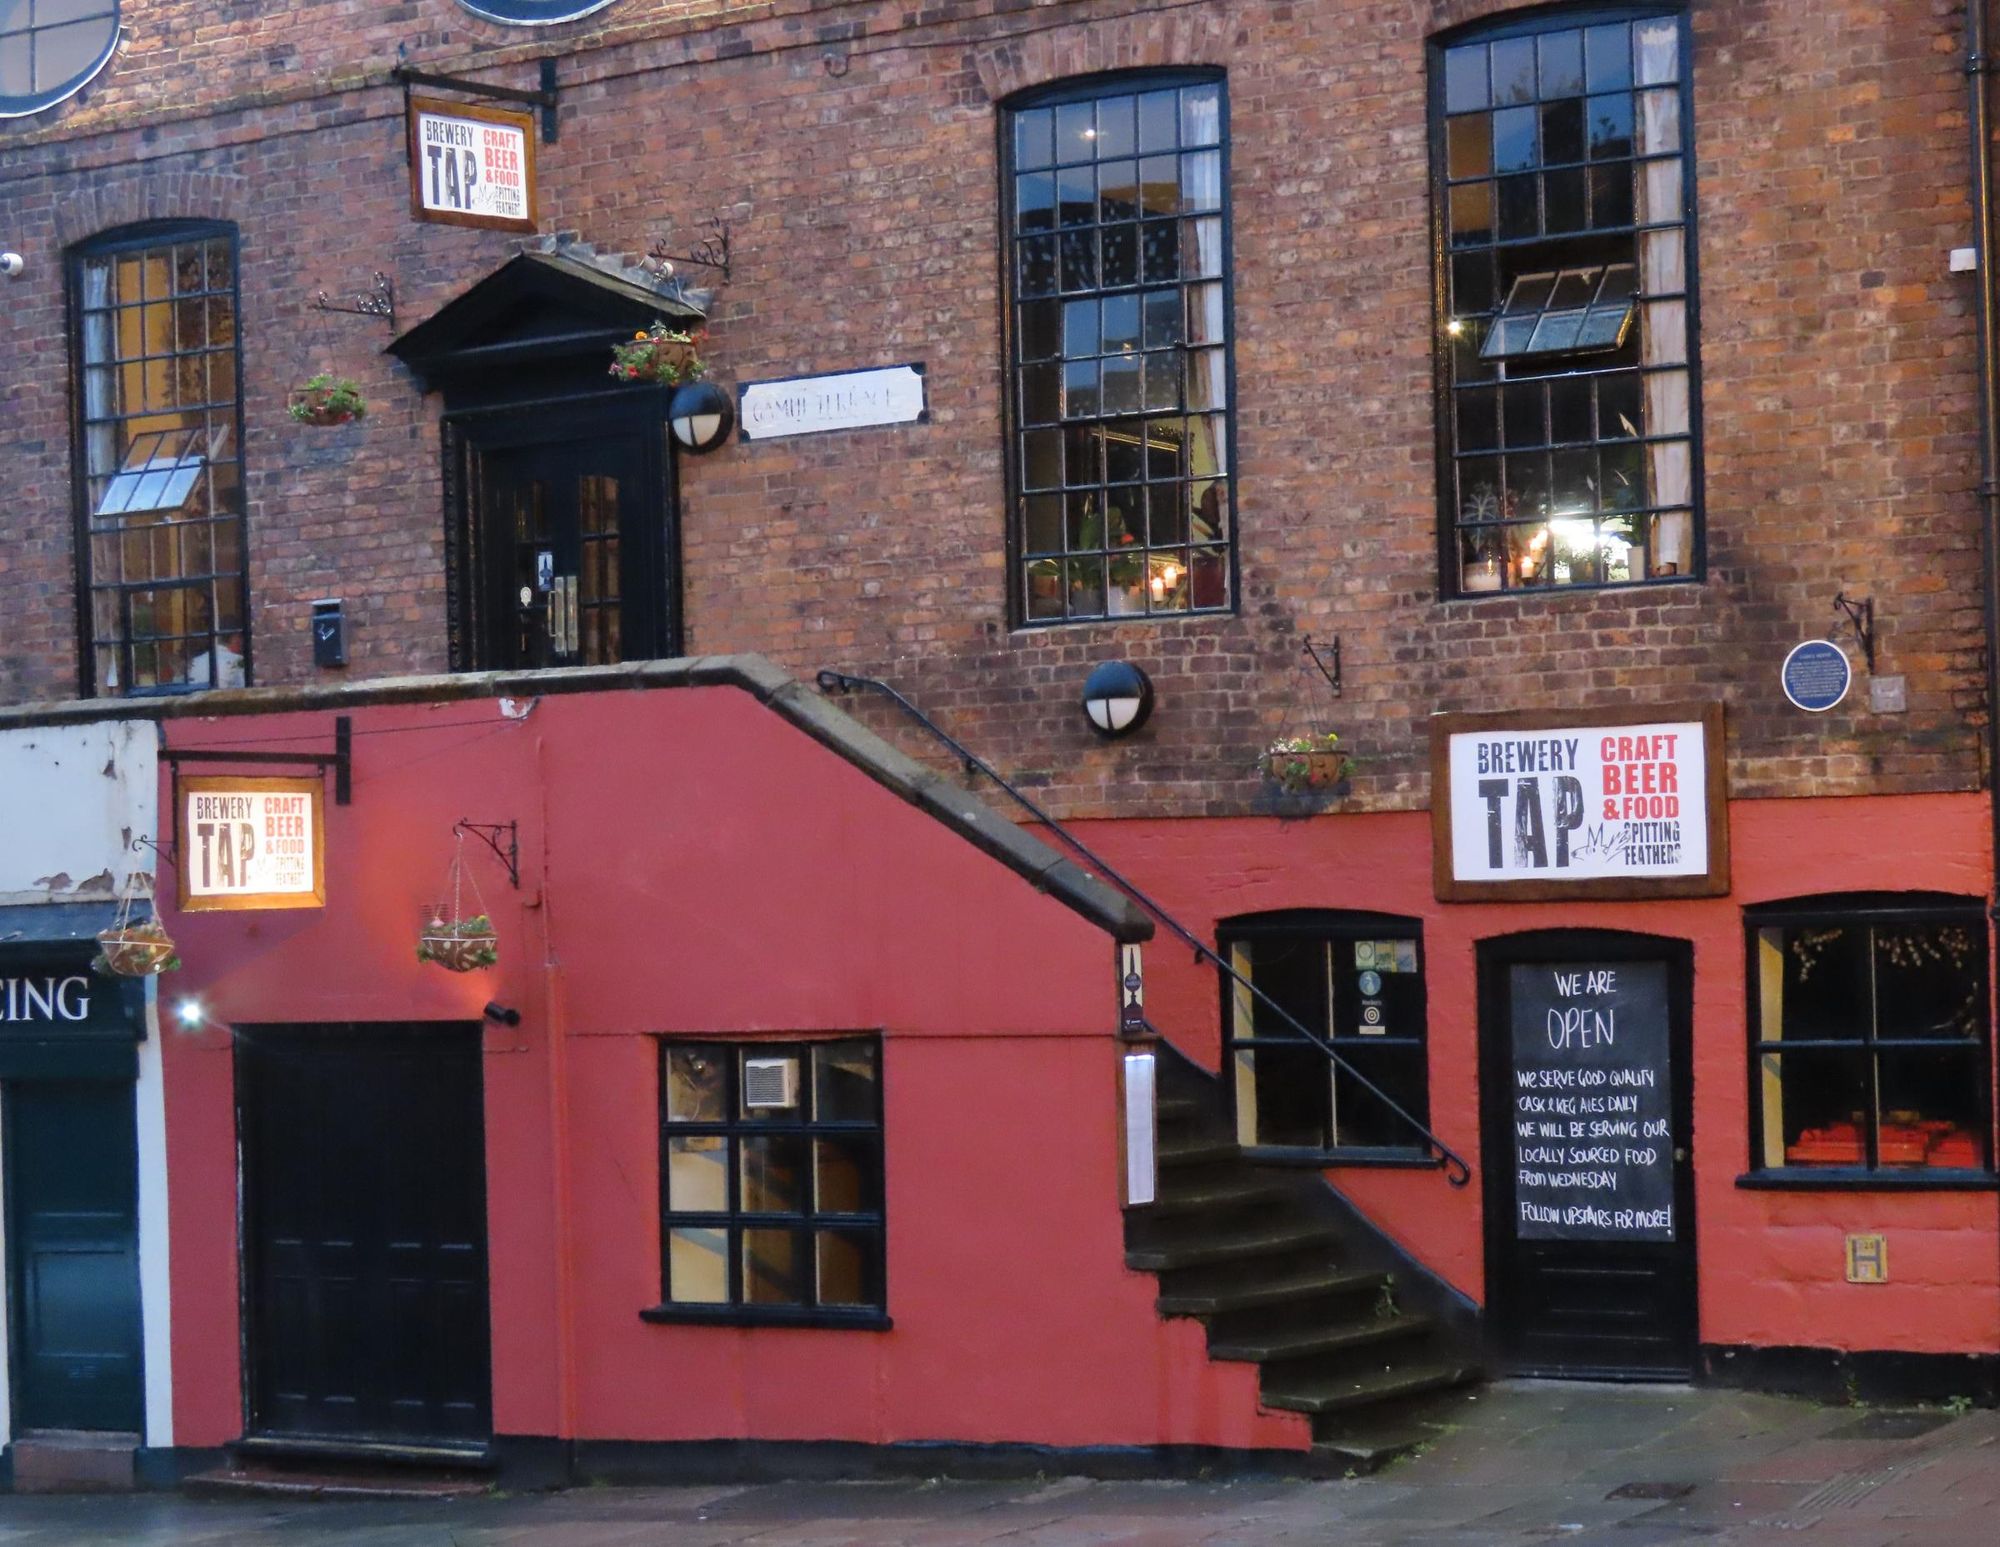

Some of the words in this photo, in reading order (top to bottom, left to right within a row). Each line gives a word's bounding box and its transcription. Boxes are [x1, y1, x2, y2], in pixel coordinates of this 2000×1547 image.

[426, 120, 474, 147] BREWERY
[483, 129, 517, 150] CRAFT
[484, 147, 518, 171] BEER
[427, 144, 478, 209] TAP
[1477, 738, 1579, 774] BREWERY
[1600, 734, 1678, 763] CRAFT
[1602, 762, 1678, 796] BEER
[197, 796, 253, 820] BREWERY
[264, 797, 304, 814] CRAFT
[265, 816, 304, 837] BEER
[1478, 775, 1585, 869] TAP
[1623, 820, 1680, 843] SPITTING
[197, 822, 255, 888] TAP
[1555, 971, 1582, 997] WE
[1586, 970, 1617, 996] ARE
[1547, 1007, 1614, 1049] OPEN
[1539, 1069, 1575, 1089] SERVE
[1578, 1069, 1606, 1087] GOOD
[1609, 1069, 1654, 1087] QUALITY
[1519, 1095, 1545, 1112] CASK
[1556, 1096, 1576, 1115] KEG
[1580, 1097, 1604, 1113] ALES
[1608, 1095, 1637, 1113] DAILY
[1517, 1121, 1536, 1138] WE
[1540, 1122, 1565, 1138] WILL
[1570, 1121, 1586, 1137] BE
[1588, 1120, 1637, 1138] SERVING
[1643, 1118, 1670, 1137] OUR
[1519, 1146, 1564, 1165] LOCALLY
[1568, 1146, 1619, 1165] SOURCED
[1625, 1148, 1657, 1166] FOOD
[1548, 1170, 1617, 1191] WEDNESDAY
[1521, 1201, 1560, 1224] FOLLOW
[1563, 1205, 1612, 1228] UPSTAIRS
[1614, 1208, 1633, 1228] FOR
